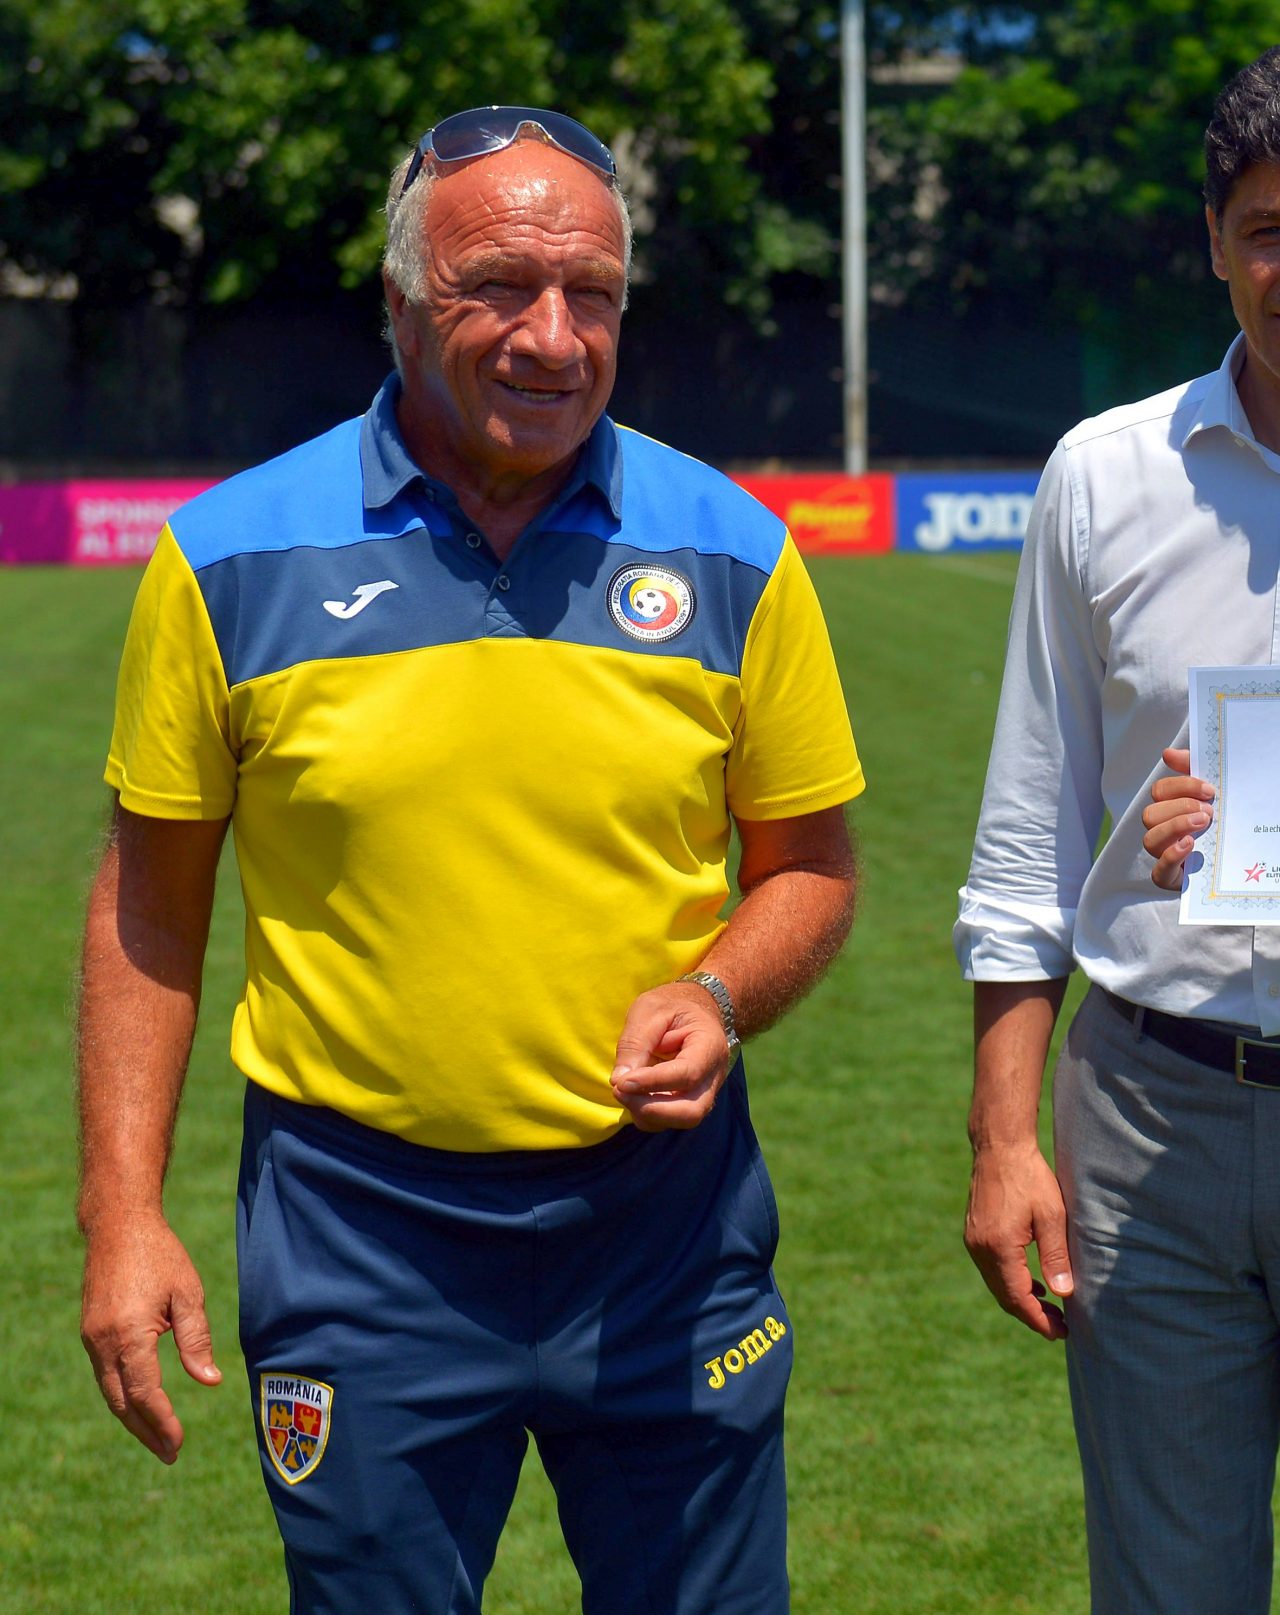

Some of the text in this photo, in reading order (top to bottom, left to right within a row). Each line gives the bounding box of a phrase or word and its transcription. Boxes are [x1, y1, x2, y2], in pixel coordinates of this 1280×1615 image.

[1253, 825, 1262, 833] de
[704, 1316, 787, 1389] Joma
[268, 1379, 322, 1405] ROMÂNIA
